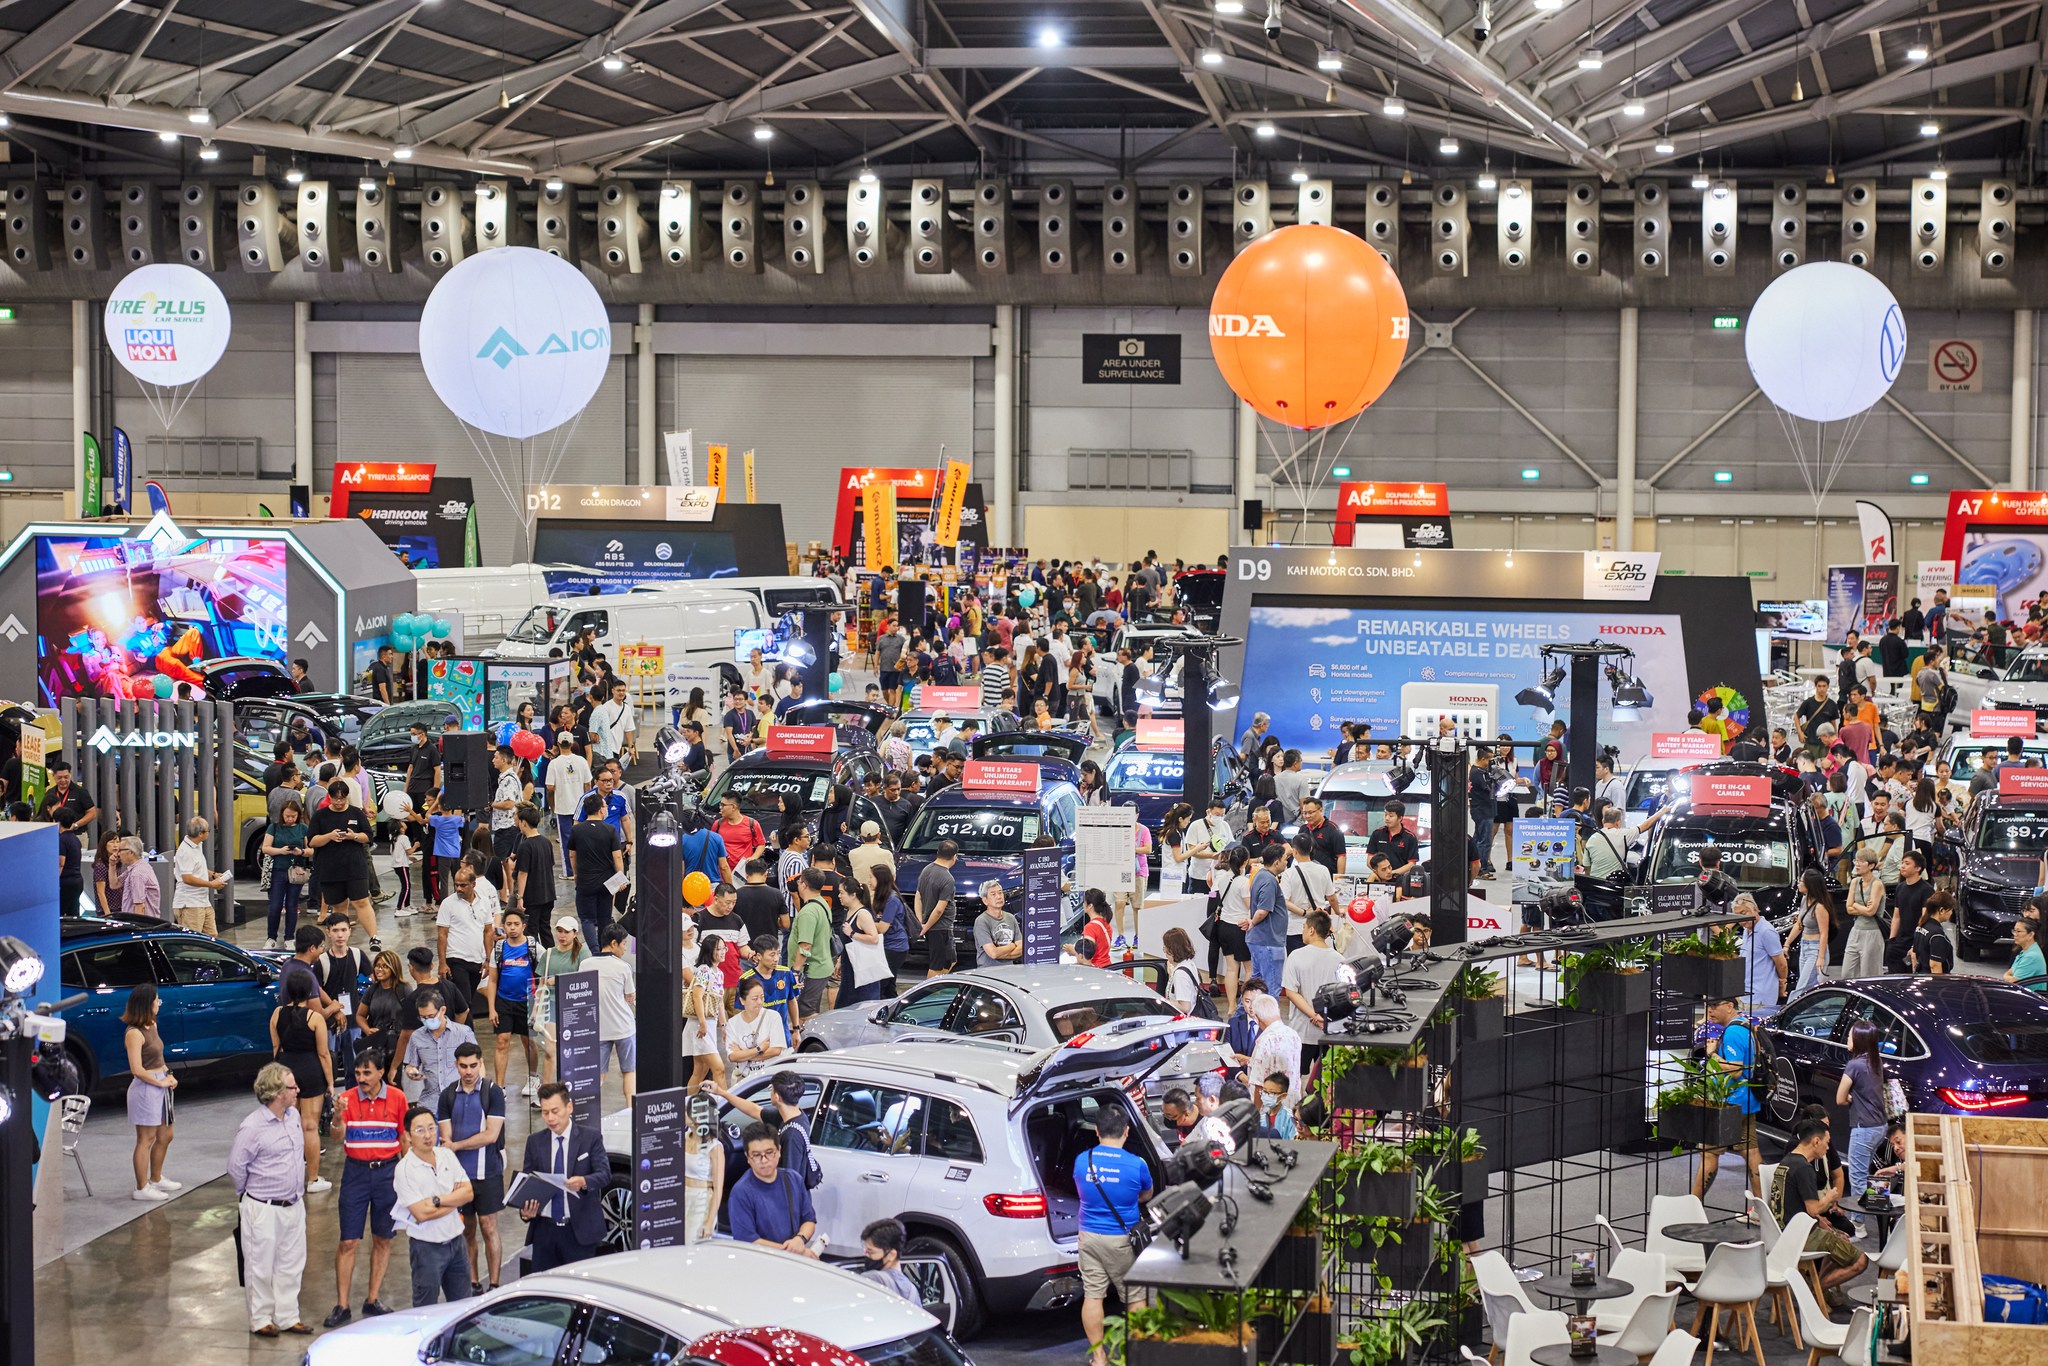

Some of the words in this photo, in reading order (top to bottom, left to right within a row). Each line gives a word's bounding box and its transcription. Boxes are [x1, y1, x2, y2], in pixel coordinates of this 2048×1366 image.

[107, 300, 146, 314] TYRE
[152, 300, 206, 315] PLUS
[1714, 317, 1738, 329] EXIT
[126, 330, 173, 345] LIQUI
[535, 326, 610, 355] AION
[128, 345, 175, 360] MOLY
[1102, 359, 1127, 368] AREA
[1129, 359, 1161, 368] UNDER
[1098, 369, 1165, 379] SURVEILLANCE
[340, 469, 363, 484] A4
[367, 473, 396, 481] TYREPLUS
[847, 475, 870, 489] A5
[527, 494, 561, 511] D12
[580, 498, 610, 507] GOLDEN
[610, 498, 641, 507] DRAGON
[1347, 490, 1371, 506] A6
[1372, 498, 1393, 506] EVENTS
[1394, 498, 1399, 506] &
[1399, 498, 1436, 506] PRODUCTION
[680, 500, 710, 508] EXPO
[1957, 498, 1983, 515] A7
[2002, 500, 2022, 508] YUEN
[385, 519, 404, 527] driving
[1415, 531, 1445, 539] EXPO
[604, 552, 625, 560] ABS
[1238, 559, 1271, 580] D9
[1287, 565, 1308, 576] KAH
[1310, 566, 1346, 577] MOTOR
[1347, 566, 1365, 577] CO.
[1366, 567, 1389, 577] SDN.
[1391, 567, 1415, 578] BHD.
[1610, 561, 1643, 572] CAR
[1604, 572, 1646, 581] EXPO
[365, 615, 388, 631] AION
[1357, 619, 1487, 638] REMARKABLE
[1491, 622, 1571, 640] WHEELS
[1599, 625, 1667, 636] HONDA
[1365, 639, 1490, 658] UNBEATABLE
[1444, 670, 1488, 679] Complimentary
[1489, 671, 1516, 680] servicing
[1344, 689, 1385, 697] downpayment
[1449, 695, 1488, 703] HONDA
[1330, 715, 1356, 723] Sure-win
[1356, 717, 1371, 725] spin
[1978, 720, 1996, 728] UNITS
[23, 734, 42, 748] LEASE
[120, 731, 195, 748] AION
[776, 732, 825, 740] COMPLIMENTARY
[996, 779, 1033, 787] WARRANTY
[1716, 789, 1745, 797] CAMERA
[998, 815, 1022, 823] FROM
[936, 823, 1015, 836] $12,100
[1028, 861, 1059, 870] AVANTGARDE
[569, 983, 580, 991] GLB
[565, 989, 593, 1000] Progressive
[647, 1103, 661, 1115] EQA
[660, 1101, 676, 1112] 250+
[645, 1111, 679, 1124] Progressive
